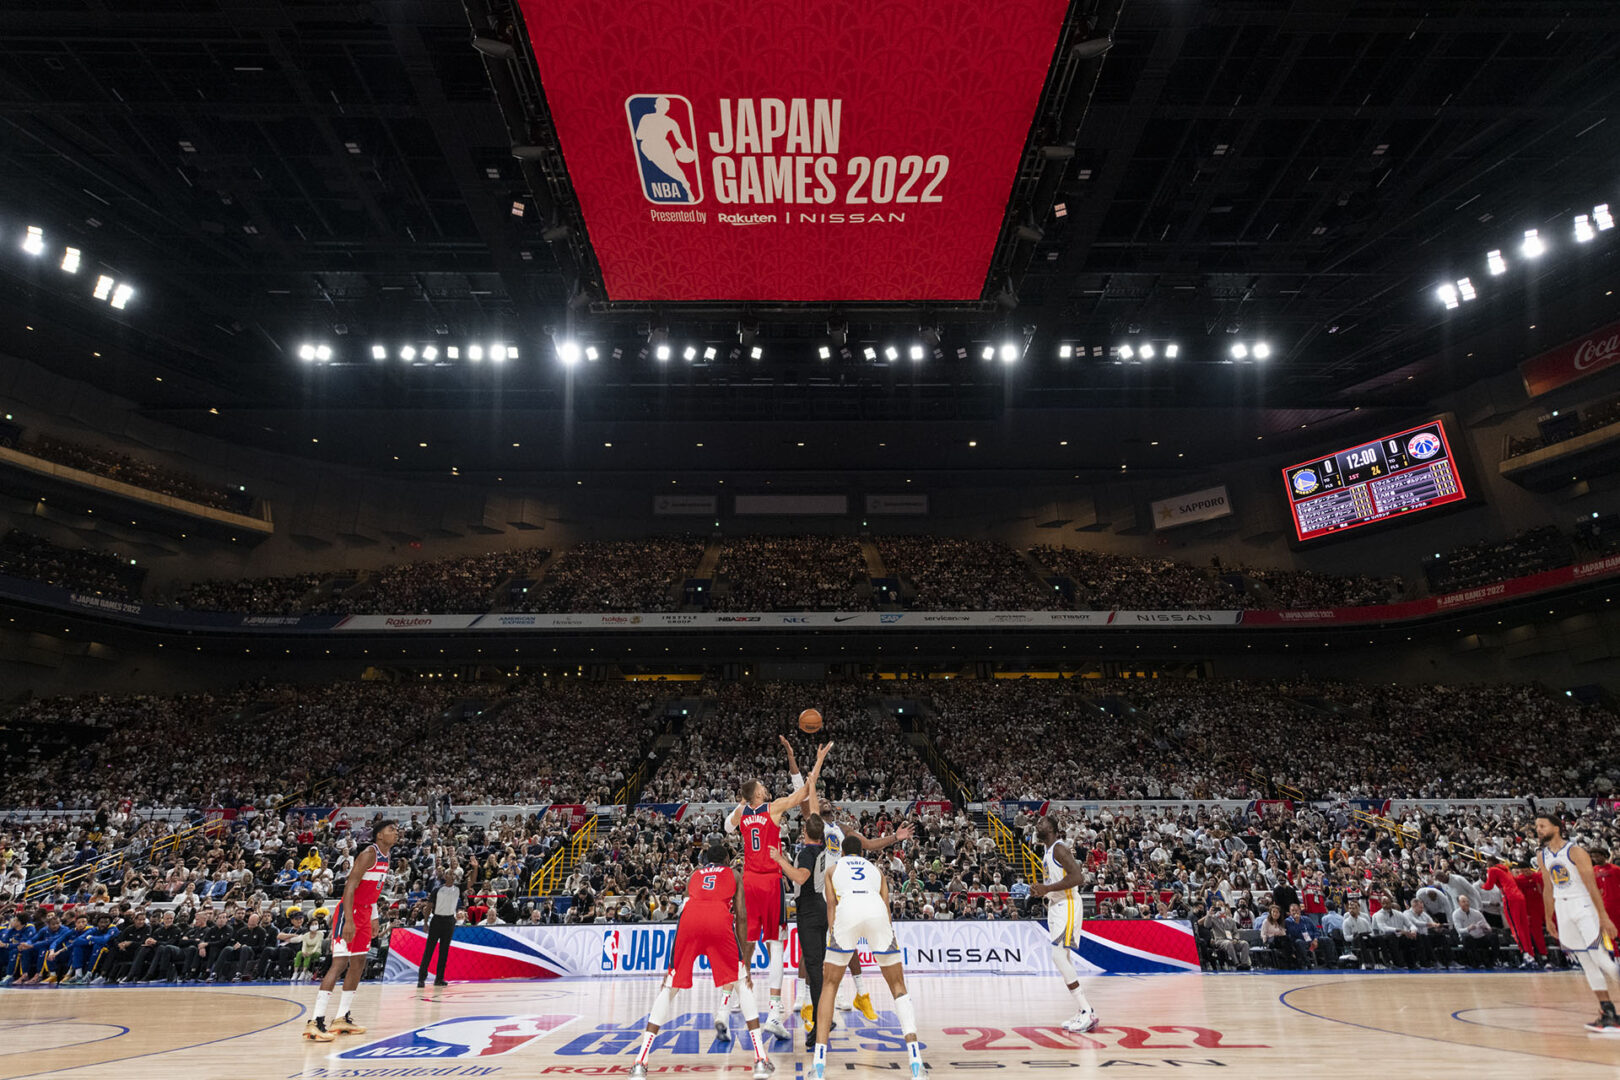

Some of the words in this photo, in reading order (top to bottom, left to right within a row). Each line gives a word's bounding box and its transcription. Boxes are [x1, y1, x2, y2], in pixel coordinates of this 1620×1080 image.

[708, 98, 842, 154] JAPAN
[711, 156, 837, 205] GAMES
[845, 155, 950, 204] 2022
[651, 182, 681, 198] NBA
[650, 209, 694, 223] Presented
[696, 209, 706, 225] by
[718, 212, 777, 225] Rakuten
[800, 213, 905, 223] NISSAN
[1574, 335, 1620, 370] Coca
[1388, 440, 1398, 454] 0
[1346, 448, 1377, 470] 12:00
[1324, 460, 1333, 474] 0
[1371, 465, 1381, 476] 24
[1348, 473, 1360, 481] 1ST
[1179, 497, 1224, 514] SAPPORO
[1487, 585, 1505, 597] 2022
[122, 602, 142, 615] 2022
[385, 617, 432, 627] Rakuten
[880, 615, 899, 623] SAP
[1136, 614, 1212, 622] NISSAN
[751, 828, 760, 852] 6
[850, 867, 865, 880] 3
[702, 875, 717, 890] 5
[622, 929, 676, 971] JAPA
[918, 949, 1021, 963] NISSAN
[942, 1026, 1273, 1050] 2022
[356, 1045, 452, 1057] NBA
[287, 1065, 463, 1079] Presented
[459, 1064, 503, 1077] by
[540, 1065, 753, 1076] Rakuten
